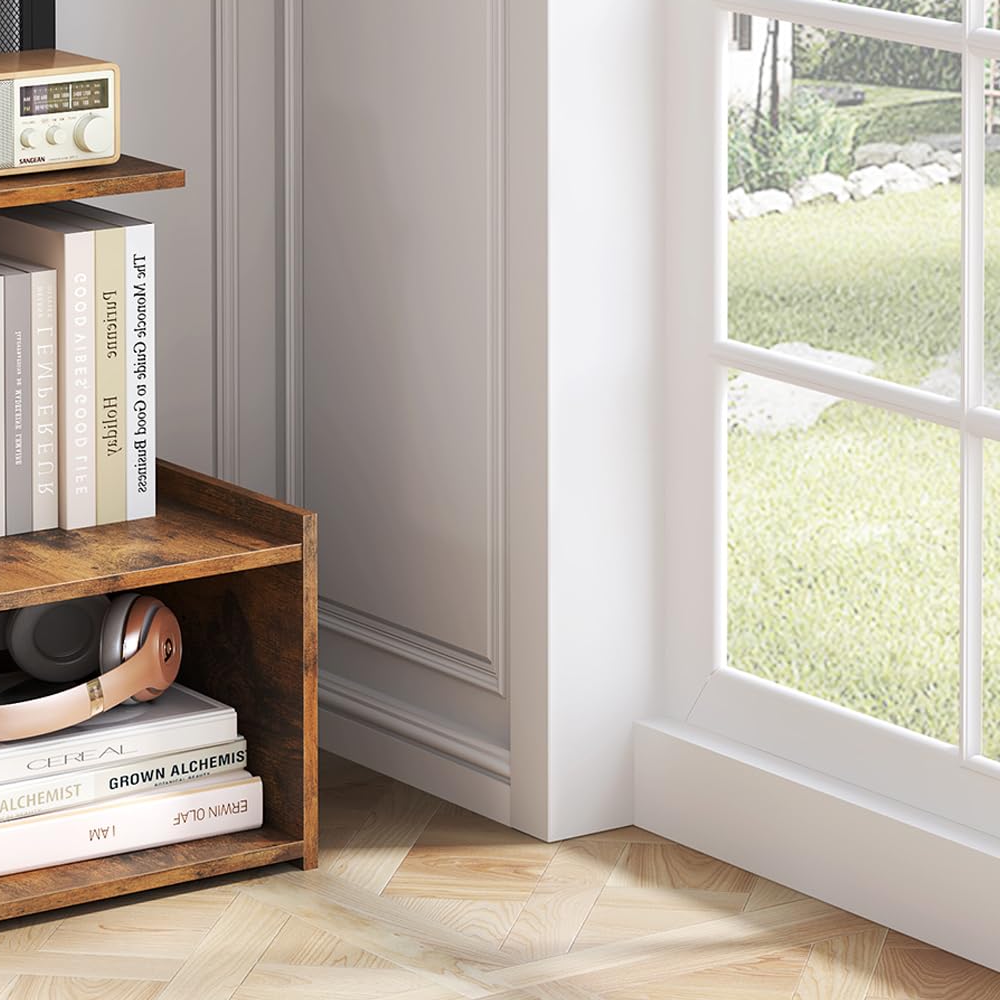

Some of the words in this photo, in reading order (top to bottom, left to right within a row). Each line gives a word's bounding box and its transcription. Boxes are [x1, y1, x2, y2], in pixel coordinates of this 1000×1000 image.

[19, 155, 46, 165] SANGEAN
[26, 744, 138, 770] CEREAL
[109, 767, 165, 790] GROWN
[170, 750, 247, 777] ALCHEMIS
[0, 783, 82, 813] ALCHEMIST
[173, 807, 206, 826] OLAF
[208, 799, 248, 819] ERWIN
[89, 826, 110, 841] AM
